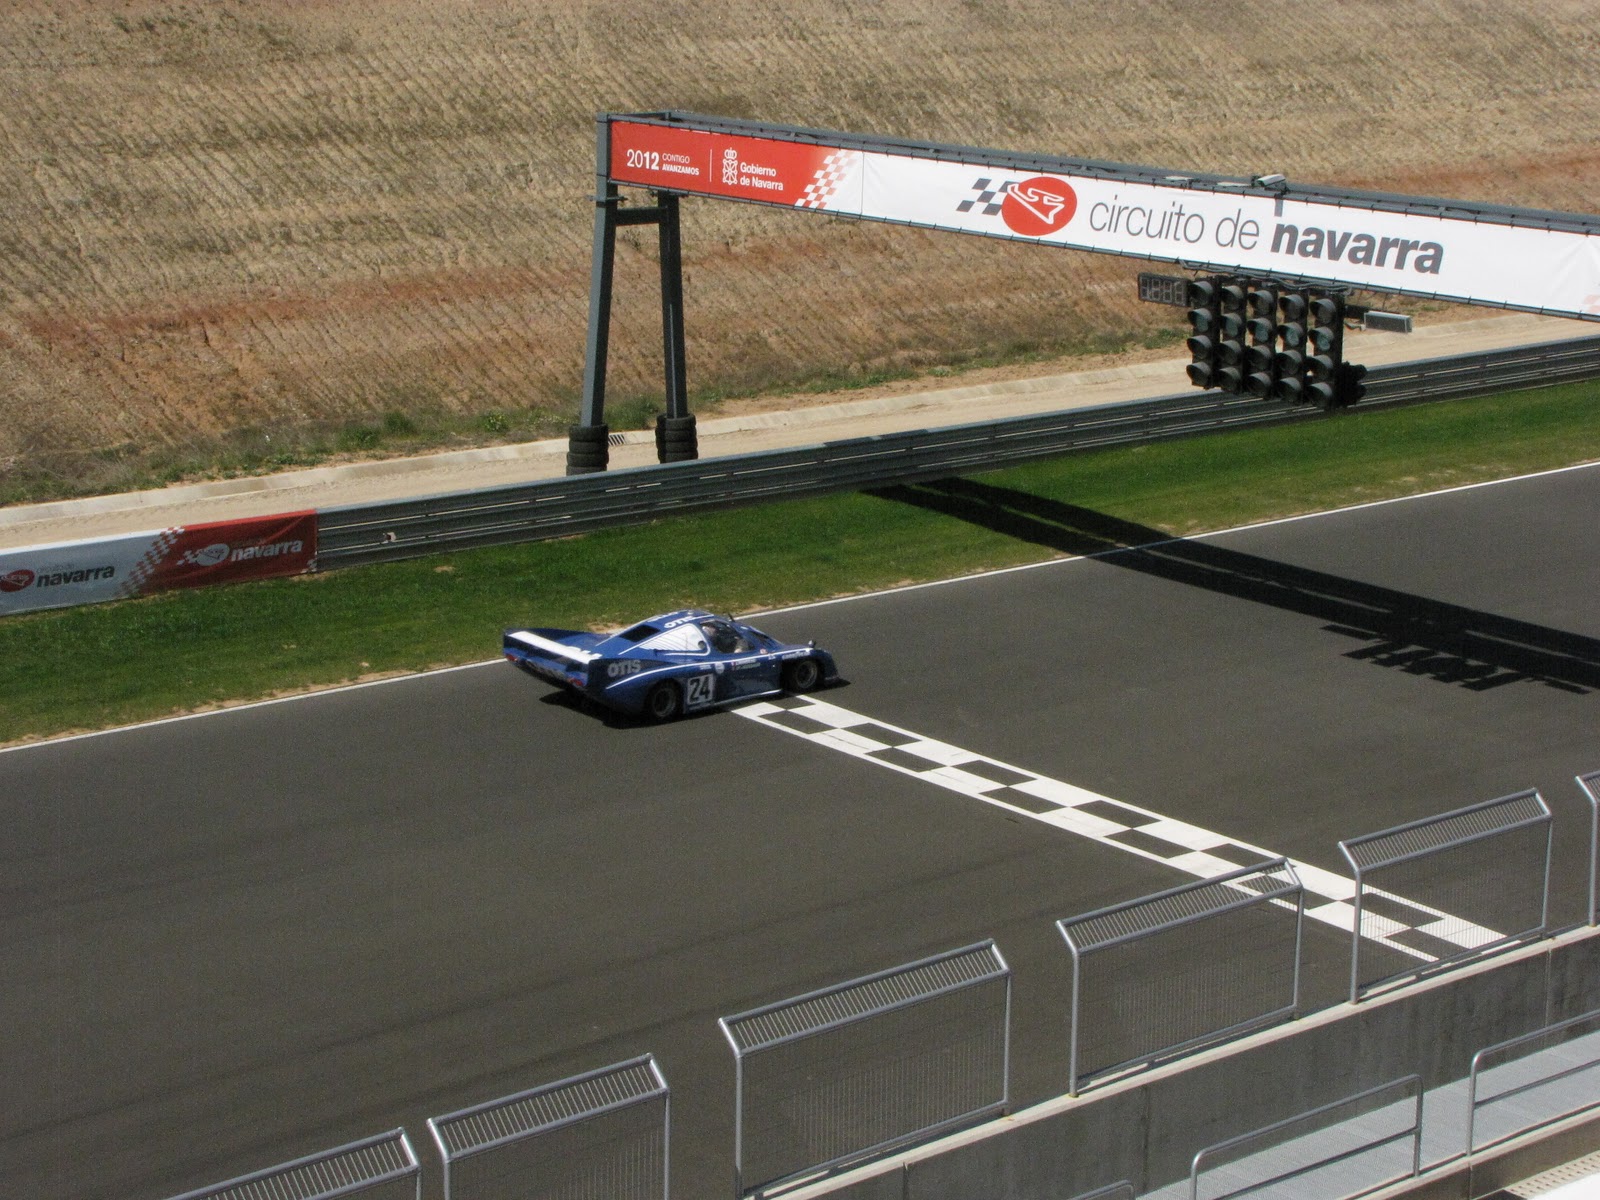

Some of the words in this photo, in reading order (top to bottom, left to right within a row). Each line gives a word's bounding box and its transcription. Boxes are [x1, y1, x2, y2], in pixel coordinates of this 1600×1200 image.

[627, 149, 660, 170] 2012
[662, 153, 690, 164] CONTIGO
[662, 164, 700, 176] AVANZAMOS
[740, 162, 777, 177] Gobierno
[740, 175, 750, 186] de
[752, 176, 784, 191] Navarra
[1089, 194, 1205, 244] circuito
[1215, 208, 1260, 251] de
[1270, 223, 1444, 275] navarra
[231, 540, 304, 562] navarra
[37, 566, 115, 588] navarra
[607, 660, 642, 678] OTIS
[689, 675, 711, 701] 24
